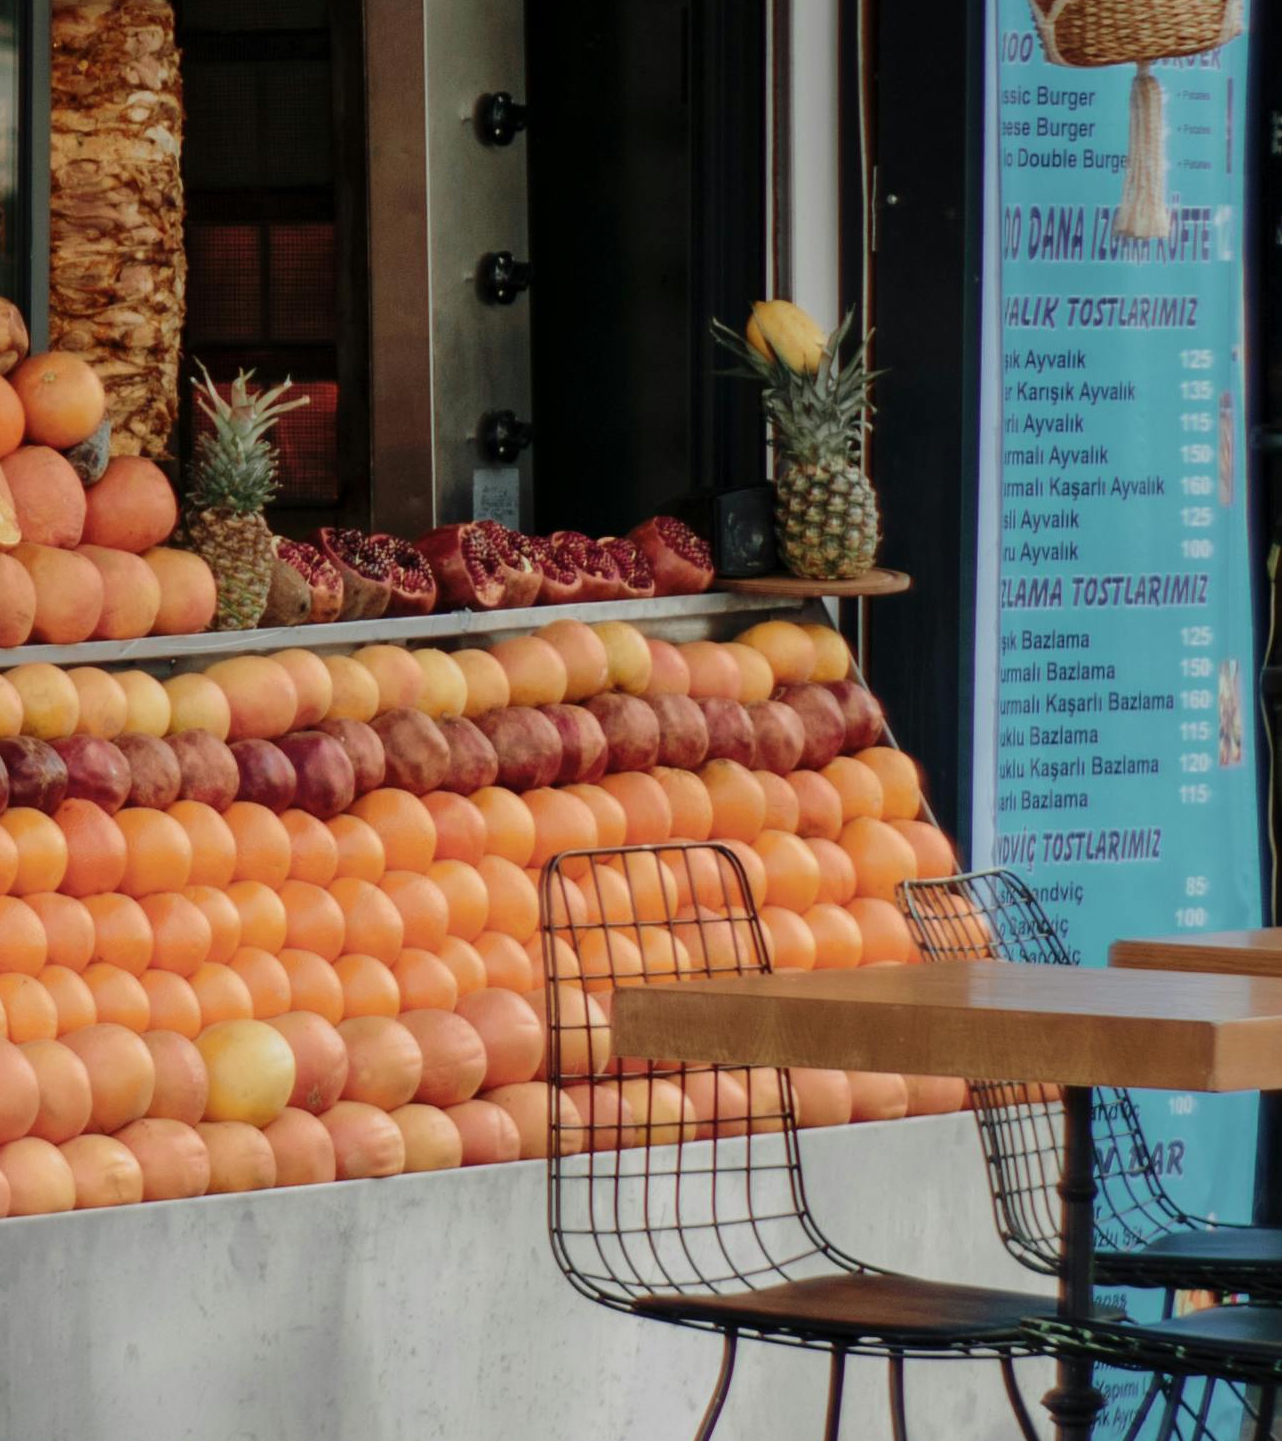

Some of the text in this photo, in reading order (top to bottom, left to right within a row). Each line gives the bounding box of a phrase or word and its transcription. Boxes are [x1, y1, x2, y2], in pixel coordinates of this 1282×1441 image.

[1001, 86, 1032, 105] ssic
[1036, 85, 1096, 111] Burger
[1036, 117, 1096, 142] Burger
[1017, 148, 1078, 169] Double
[1082, 148, 1130, 174] Burge
[1027, 206, 1085, 262] DANA
[1066, 296, 1198, 331] TOSTLARIMIZ
[1024, 348, 1087, 374] Ayvalık
[1016, 381, 1074, 406] Karışık
[1078, 380, 1136, 406] Ayvalık
[1022, 413, 1085, 439] Ayvalık
[1048, 444, 1109, 470] Ayvalık
[1048, 475, 1106, 502] Kaşarlı
[1109, 475, 1165, 501] Ayvalık
[1020, 508, 1080, 533] Ayvalık
[1020, 541, 1079, 566] Ayvalık
[1071, 573, 1209, 608] TOSTLARIMIZ
[1021, 629, 1090, 651] Bazlama
[1046, 661, 1116, 682] Bazlama
[1045, 691, 1103, 718] Kaşarlı
[1108, 691, 1175, 712] Bazlama
[1029, 725, 1099, 746] Bazlama
[1029, 756, 1086, 782] Kaşarlı
[1091, 755, 1159, 777] Bazlama
[1020, 789, 1089, 811] Bazlama
[1042, 828, 1162, 863] TOSTLARIMIZ
[1031, 881, 1084, 904] andviç
